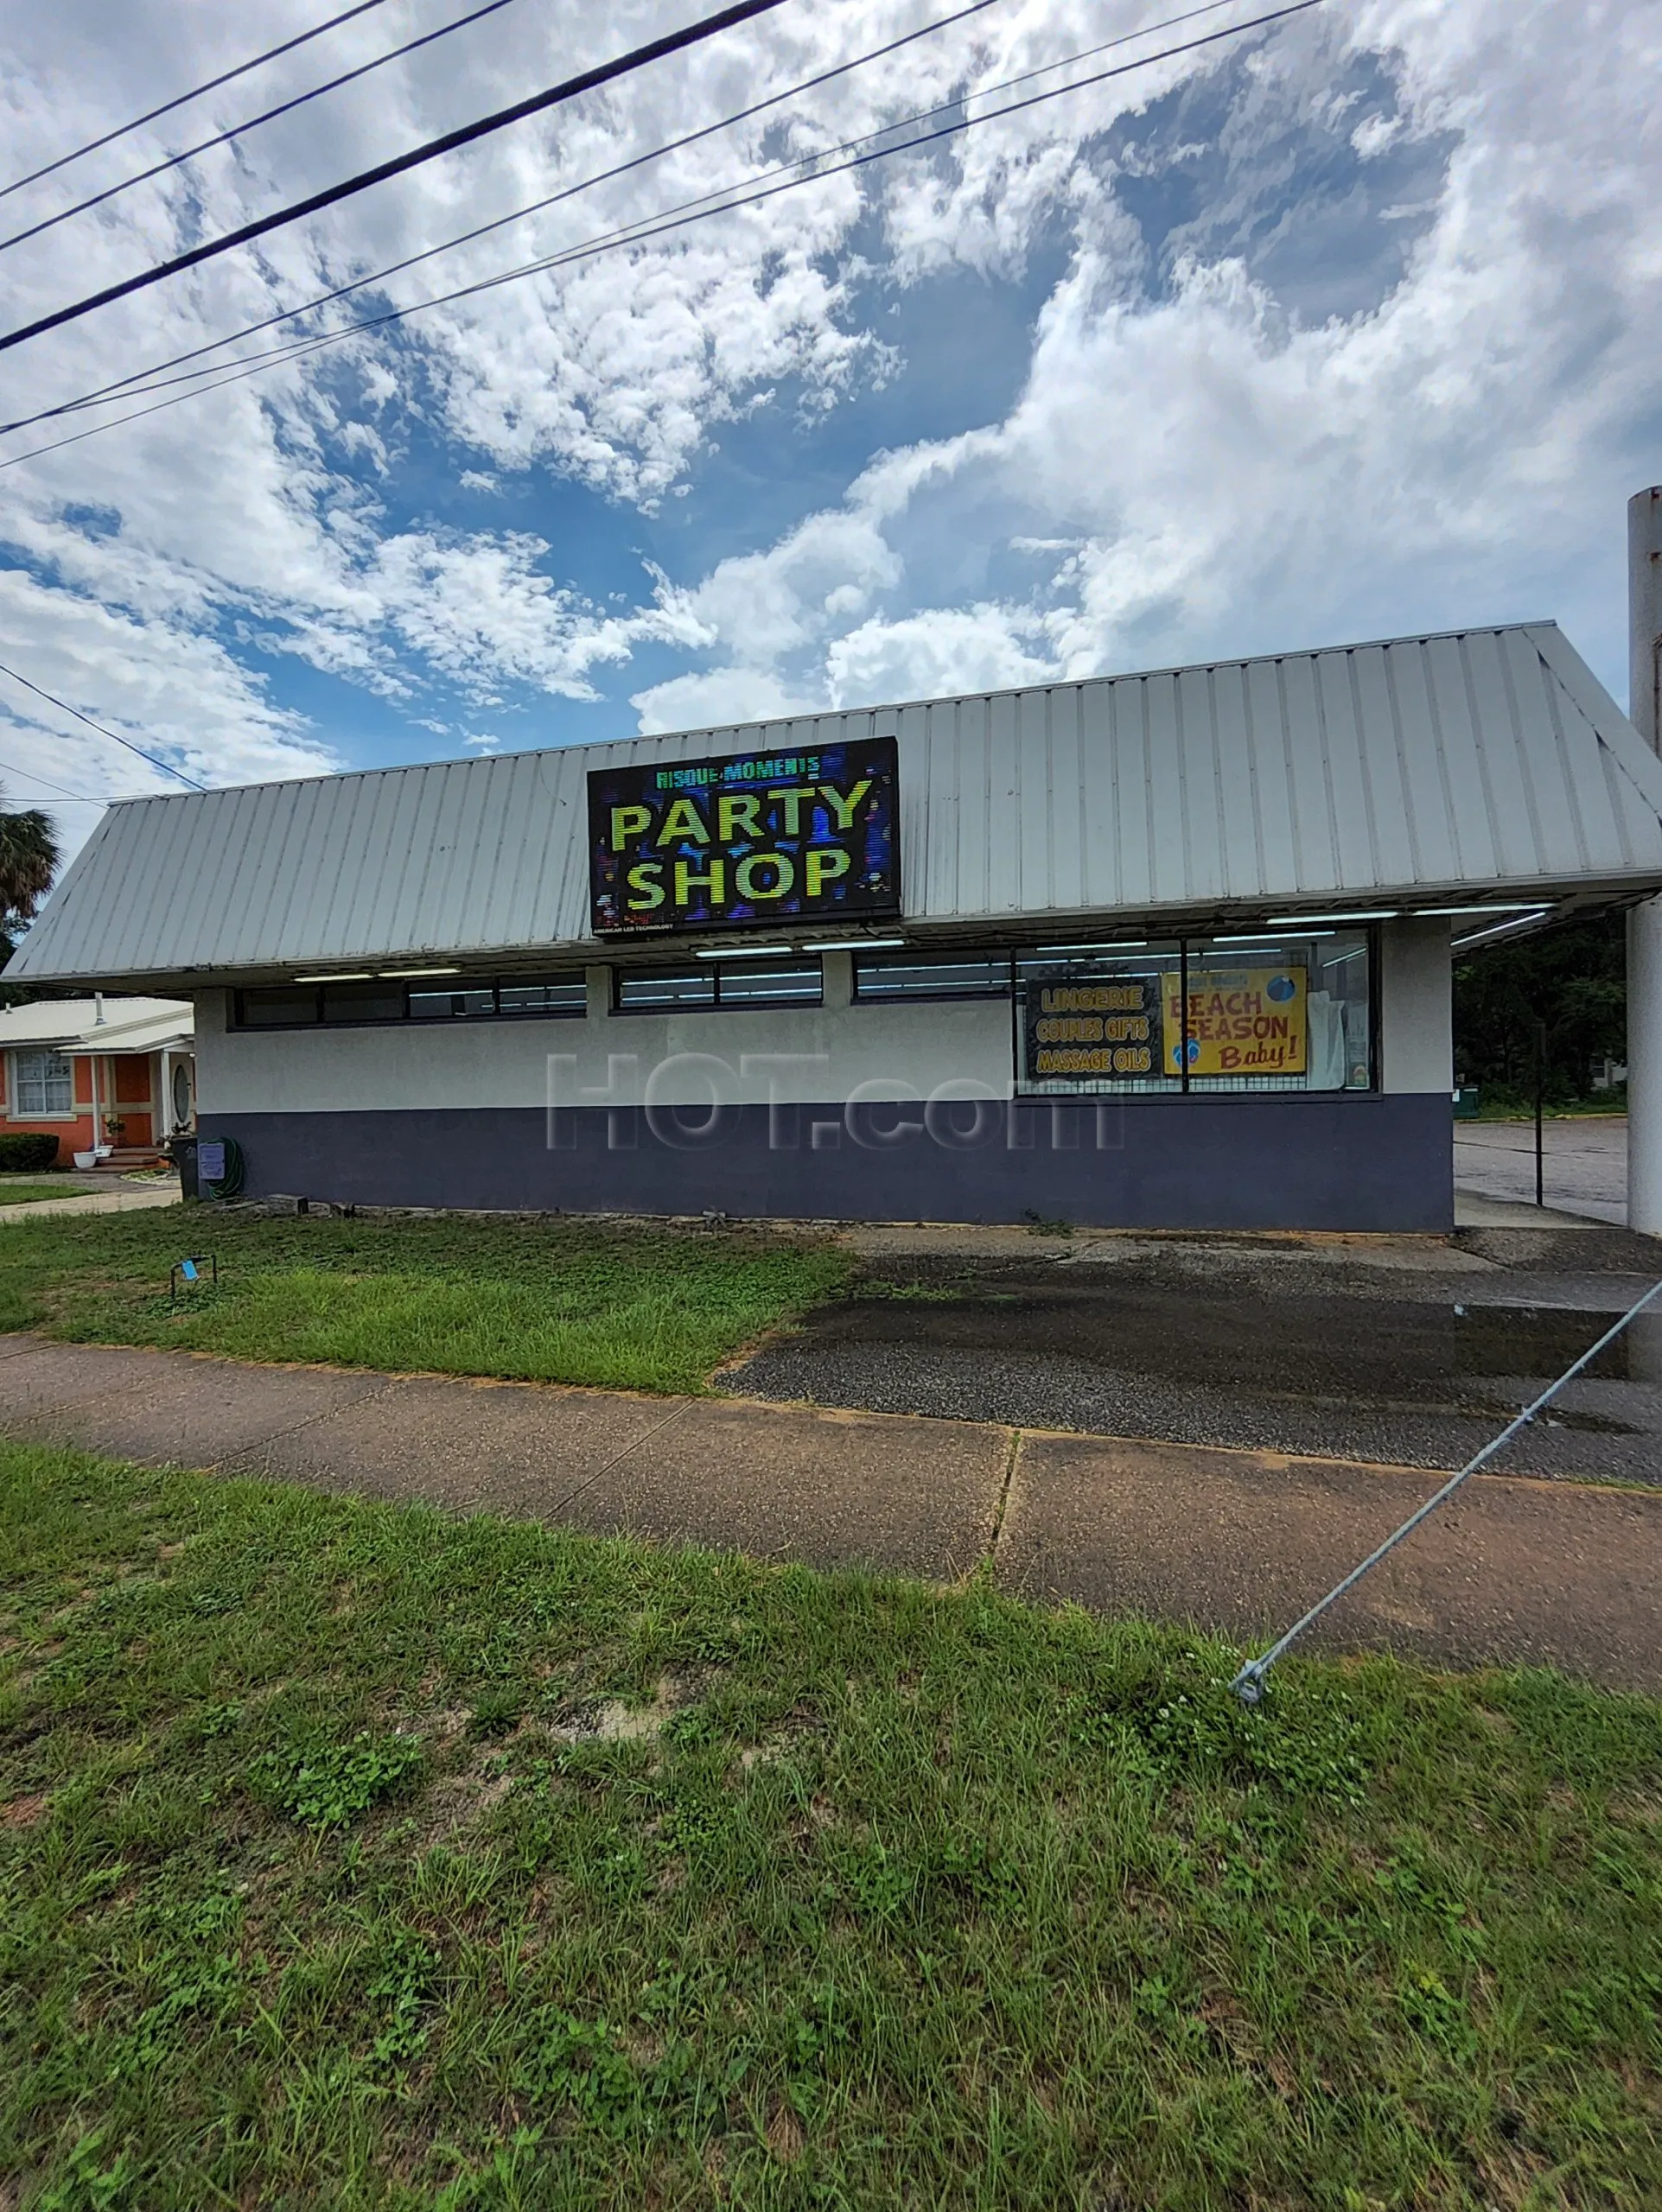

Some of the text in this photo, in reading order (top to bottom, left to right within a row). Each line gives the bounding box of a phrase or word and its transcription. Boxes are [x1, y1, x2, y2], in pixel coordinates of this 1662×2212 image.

[610, 779, 873, 852] PARTY
[627, 849, 851, 911] SHOP
[1041, 986, 1143, 1011] LINGERIE
[1170, 991, 1262, 1018] BEACH
[1037, 1016, 1149, 1042] COUPLES GIFTS
[1179, 1015, 1289, 1040] SEASON
[1037, 1047, 1150, 1073] MASSAGE OILS
[1219, 1035, 1298, 1070] Baby!
